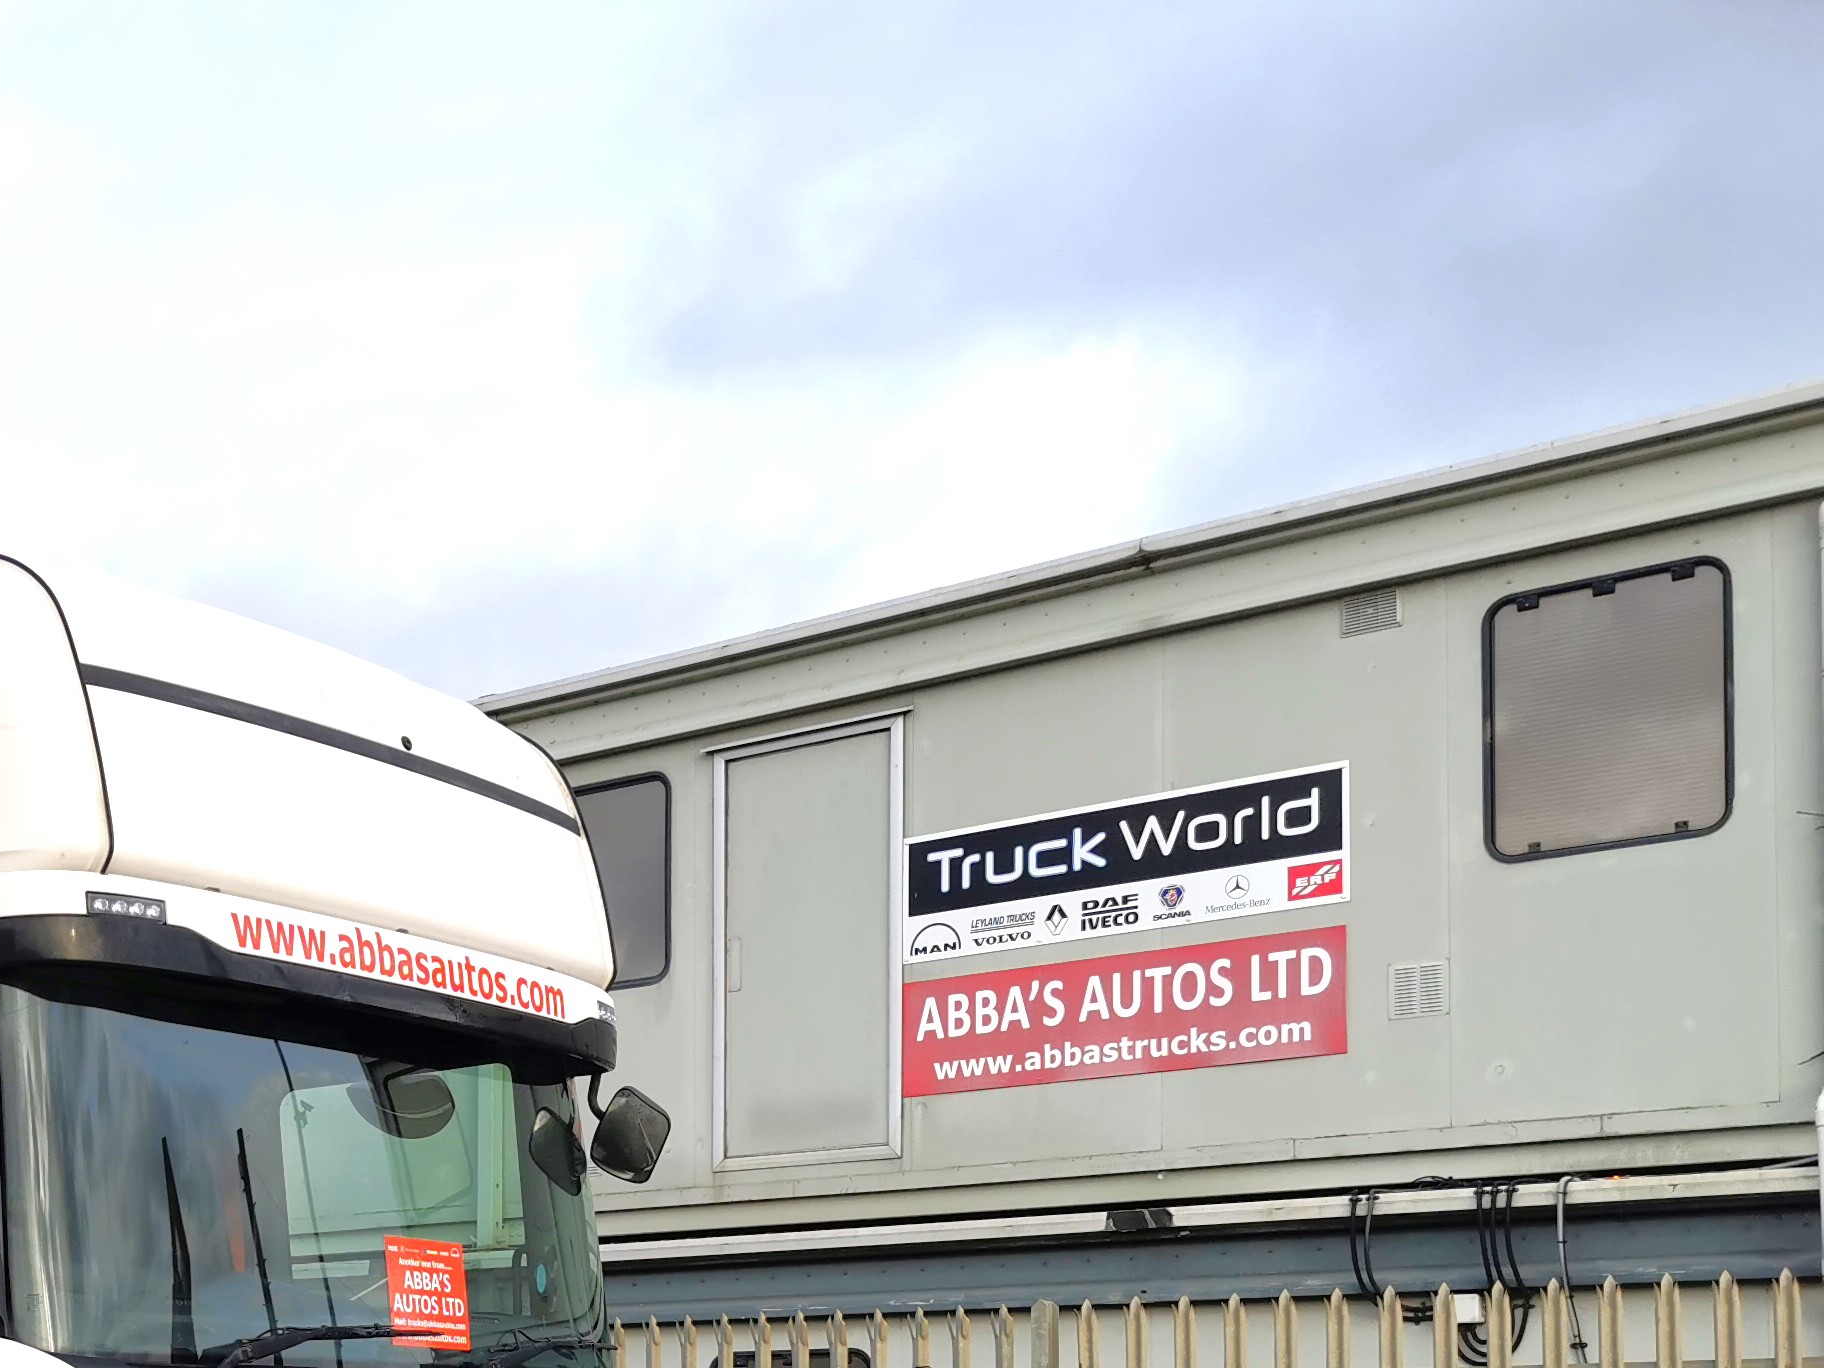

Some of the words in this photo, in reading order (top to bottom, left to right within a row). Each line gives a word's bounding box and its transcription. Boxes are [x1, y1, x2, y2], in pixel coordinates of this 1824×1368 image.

[926, 827, 1108, 893] Truck
[1118, 787, 1321, 861] World
[1294, 872, 1338, 887] ERF
[1081, 893, 1138, 911] DAF
[1204, 898, 1271, 915] Mercedes-Benz
[970, 915, 1005, 929] LEYLAND
[1006, 911, 1036, 924] TRUCKS
[1081, 911, 1139, 932] IVECO
[1152, 909, 1192, 922] SCANIA
[972, 930, 1032, 947] VOLVO
[913, 940, 958, 956] MAN
[229, 911, 567, 1020] www.abbasautos.com
[1078, 958, 1234, 1023] AUTOS
[1249, 946, 1333, 1003] LTD
[933, 1021, 1312, 1081] www.abbastrucks.com
[393, 1292, 439, 1315] AUTOS
[441, 1296, 465, 1317] LTD
